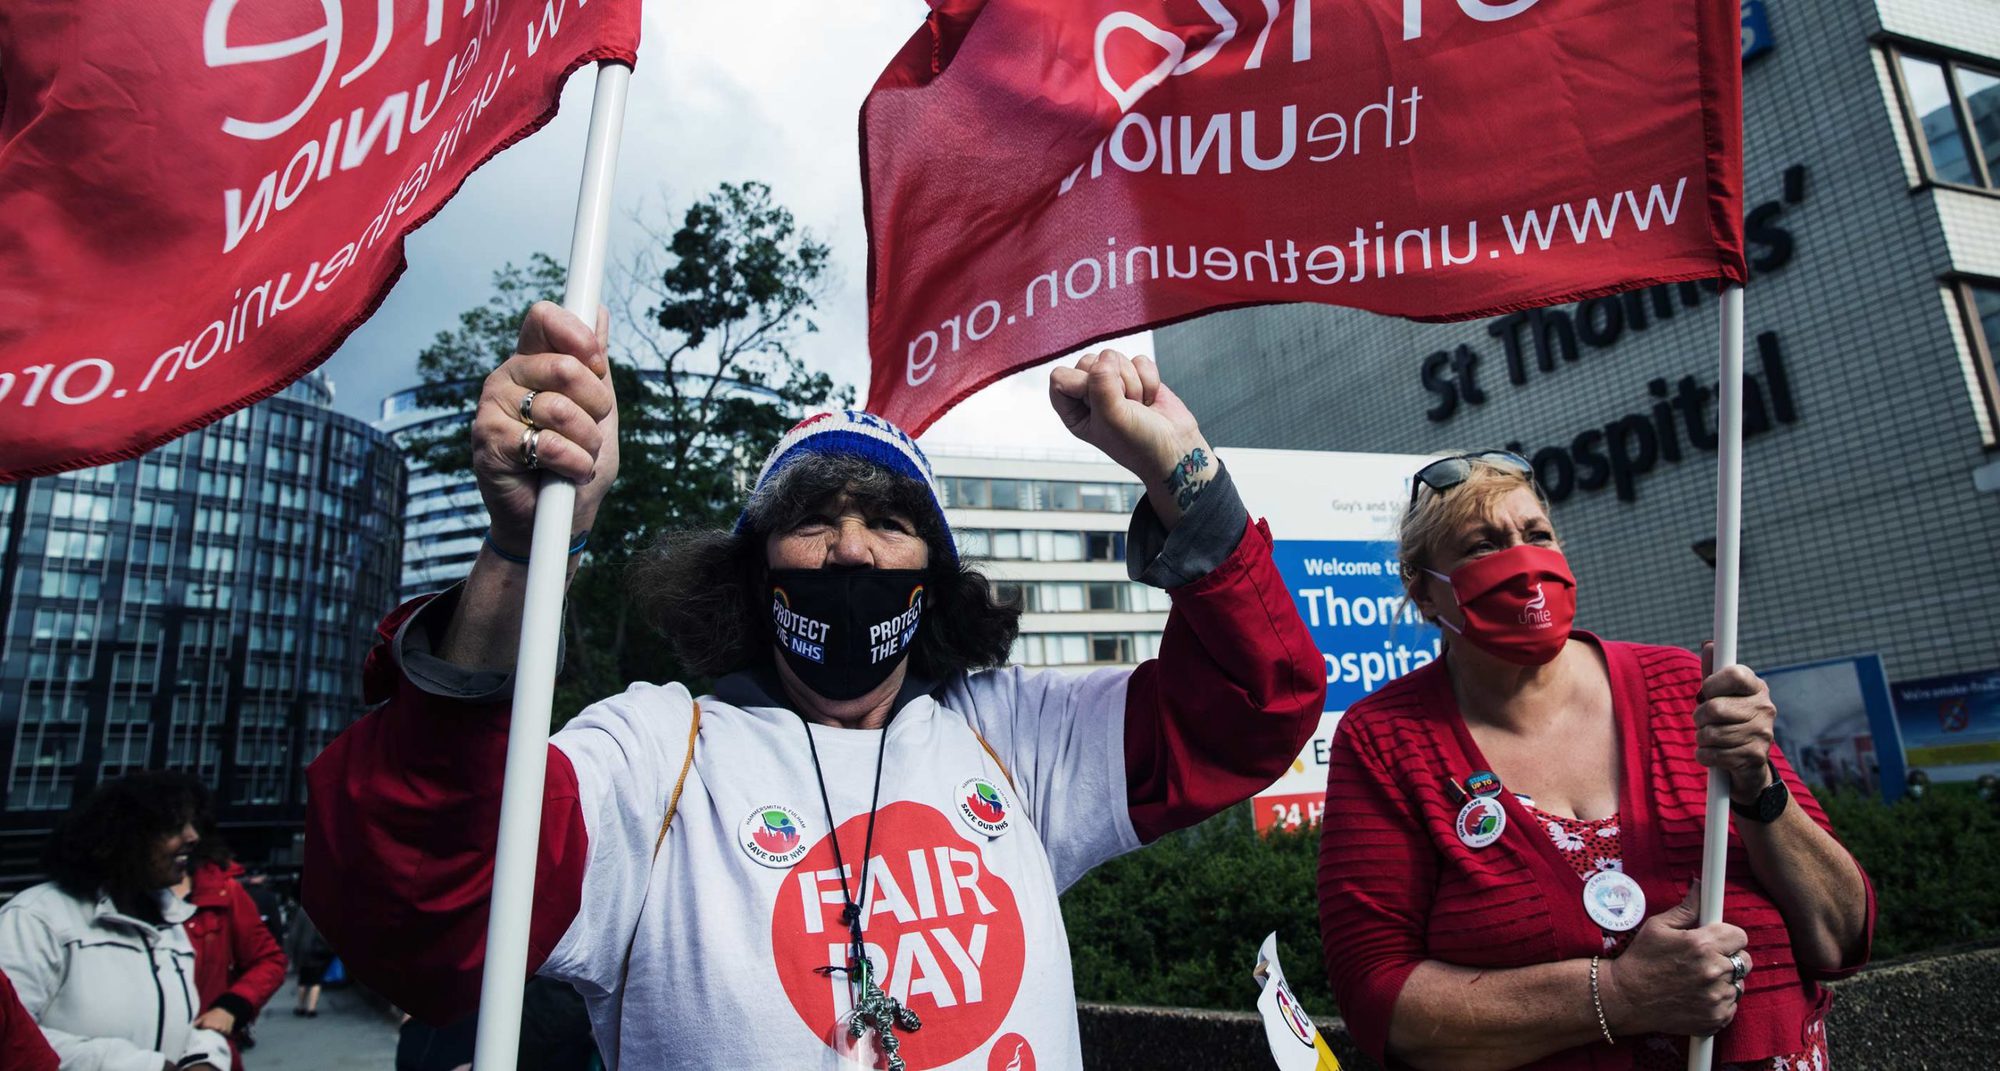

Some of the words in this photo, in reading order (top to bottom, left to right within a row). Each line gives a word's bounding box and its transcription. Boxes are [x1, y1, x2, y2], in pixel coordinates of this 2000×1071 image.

[1420, 343, 1486, 423] St
[1506, 330, 1798, 504] ospital
[1366, 501, 1386, 511] and
[1304, 558, 1382, 577] Welcome
[772, 598, 830, 644] PROTECT
[869, 596, 922, 646] PROTECT
[791, 637, 824, 663] NHS
[870, 637, 899, 665] THE
[961, 803, 978, 823] SAVE
[977, 820, 994, 832] OUR
[994, 820, 1009, 832] NHS
[746, 841, 768, 860] SAVE
[768, 854, 789, 863] OUR
[789, 844, 807, 860] NHS
[797, 846, 998, 934] FAIR
[828, 924, 989, 1022] PAY
